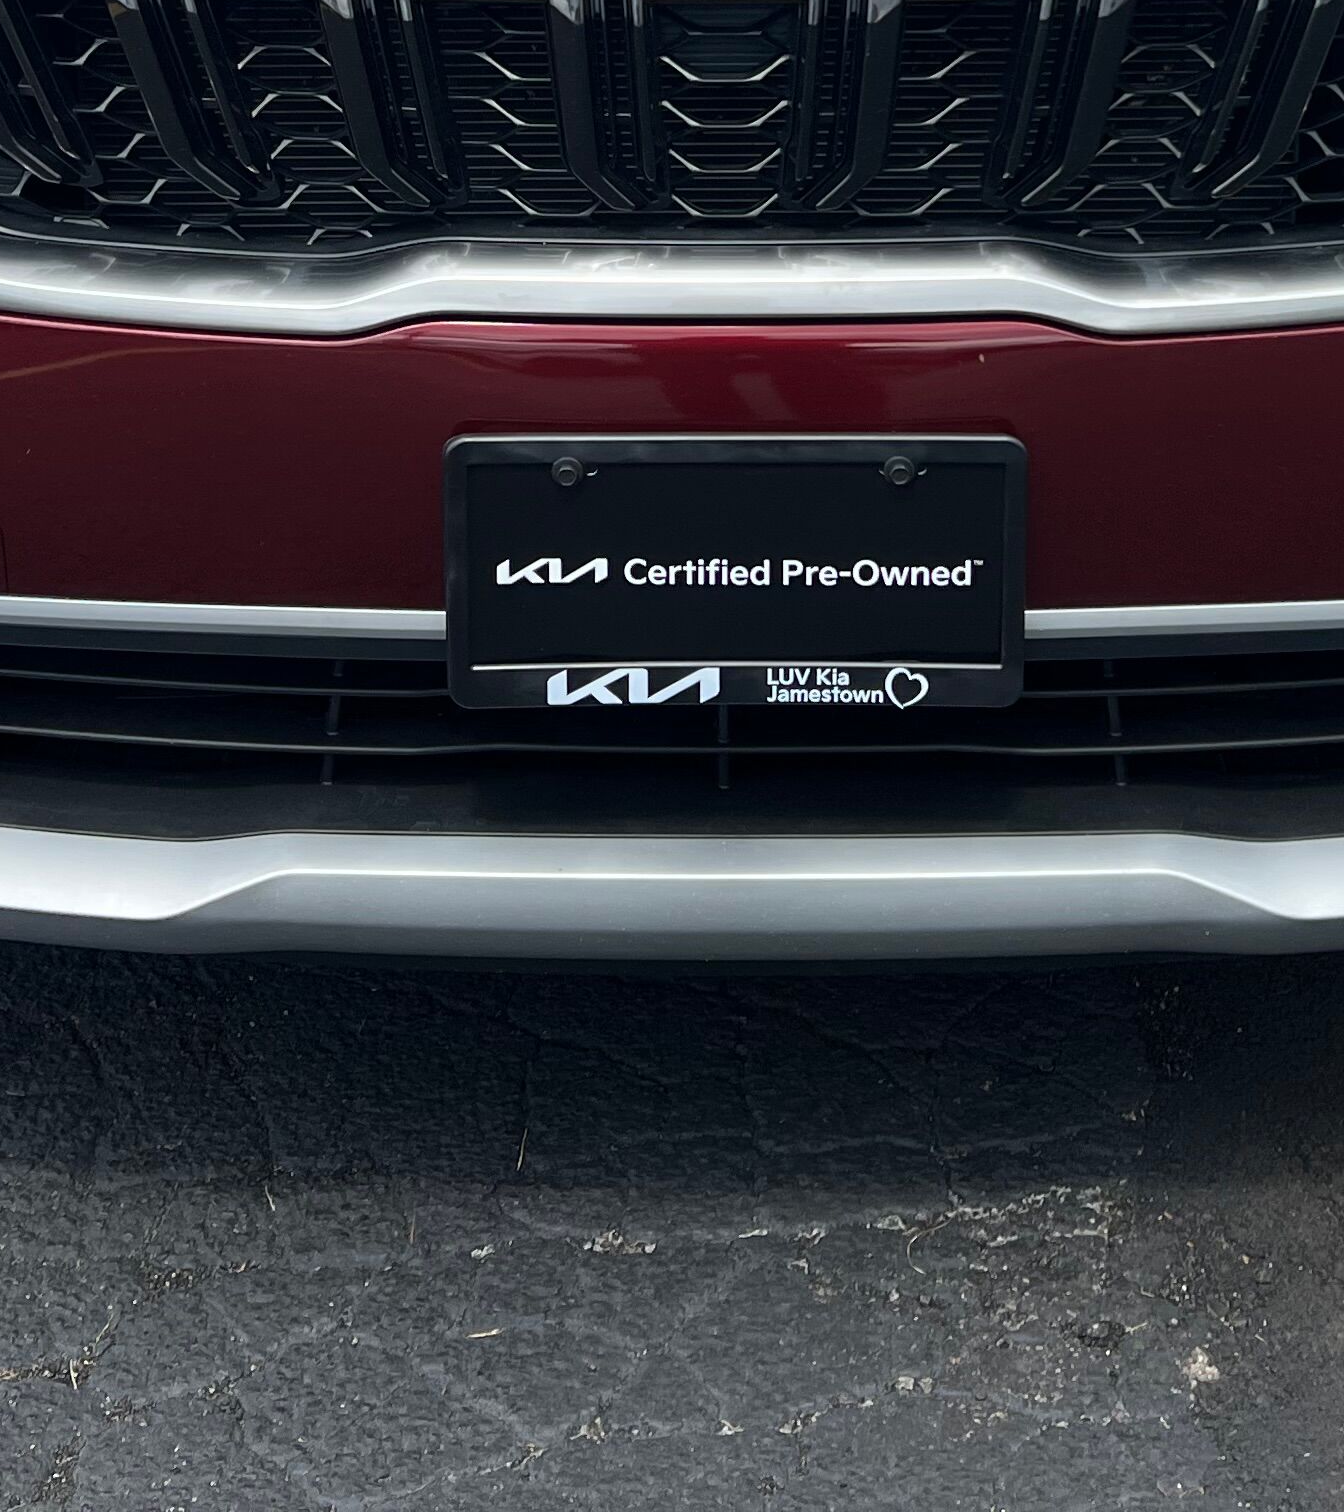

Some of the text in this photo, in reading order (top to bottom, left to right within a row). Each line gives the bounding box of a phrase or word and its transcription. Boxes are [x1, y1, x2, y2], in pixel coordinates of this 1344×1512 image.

[496, 557, 609, 585] KIA
[623, 557, 771, 586] Certified
[546, 666, 721, 705] KIA
[766, 667, 850, 686] LUV Kia
[766, 685, 884, 704] Jamestown
